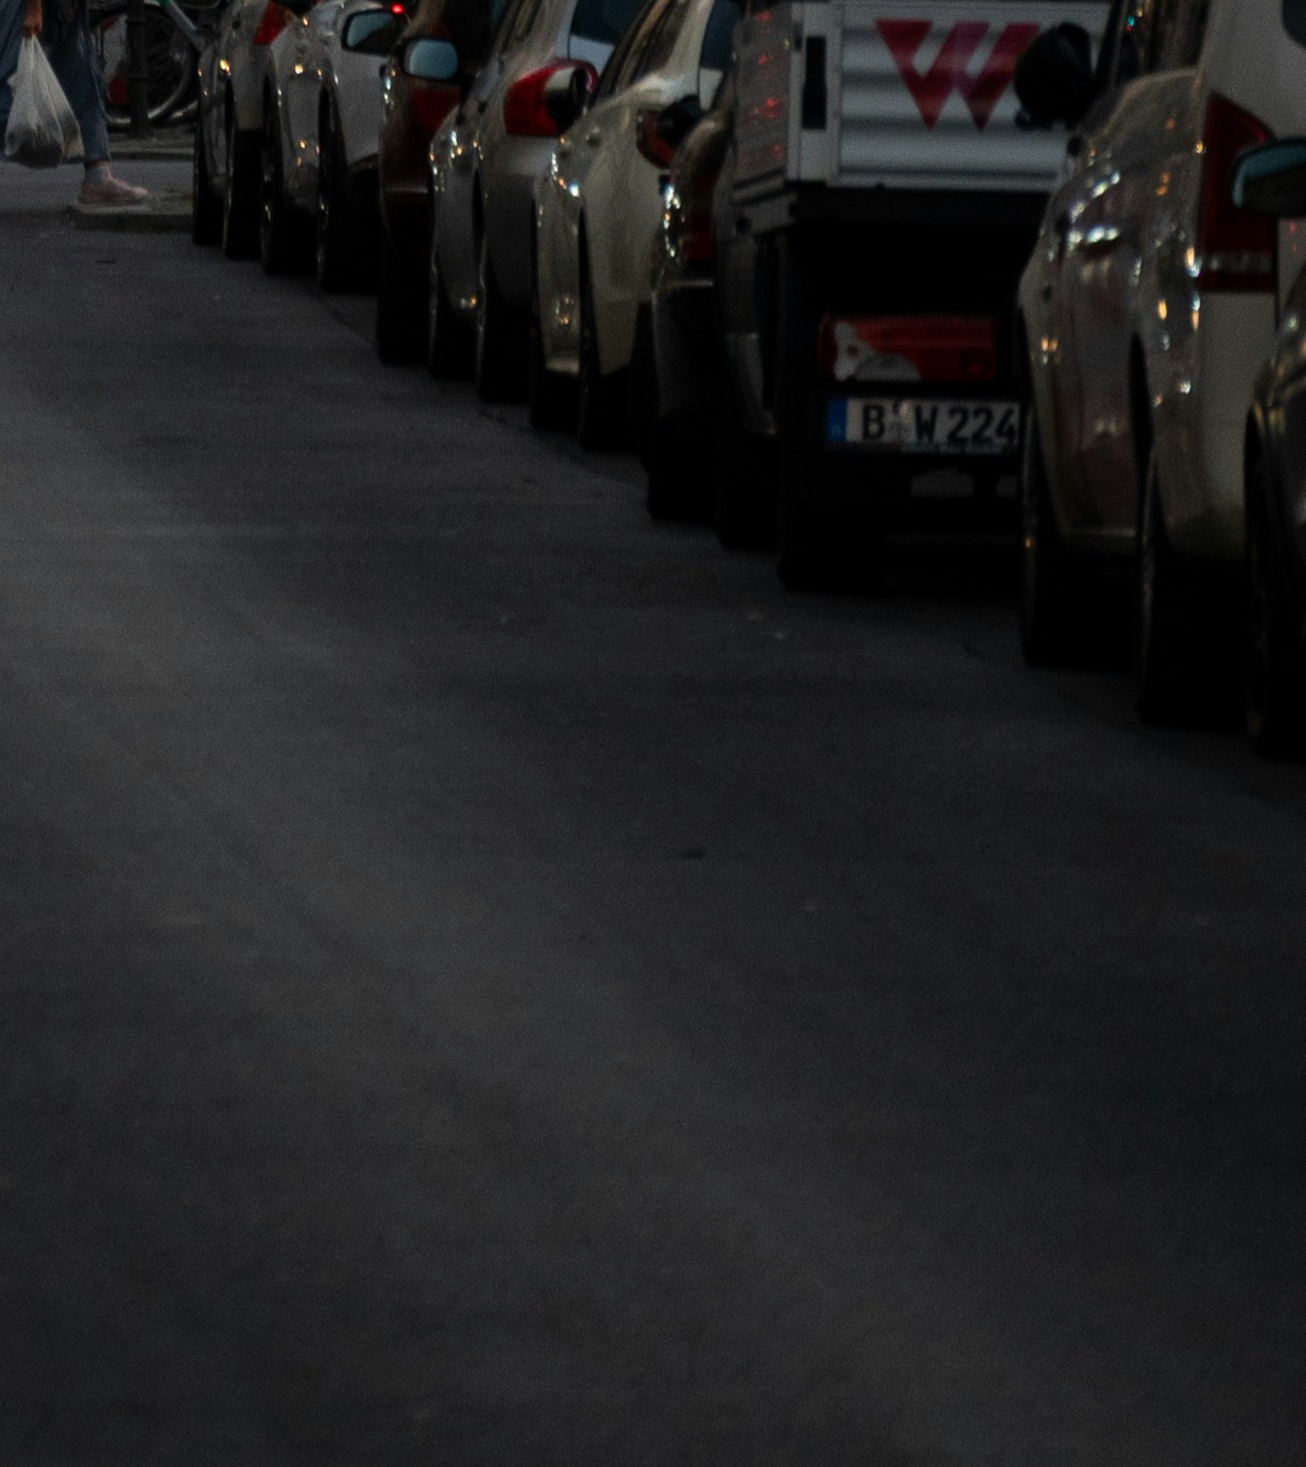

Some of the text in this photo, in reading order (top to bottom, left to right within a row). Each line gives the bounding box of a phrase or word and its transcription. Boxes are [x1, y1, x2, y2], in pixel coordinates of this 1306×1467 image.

[863, 405, 1017, 443] B W 224
